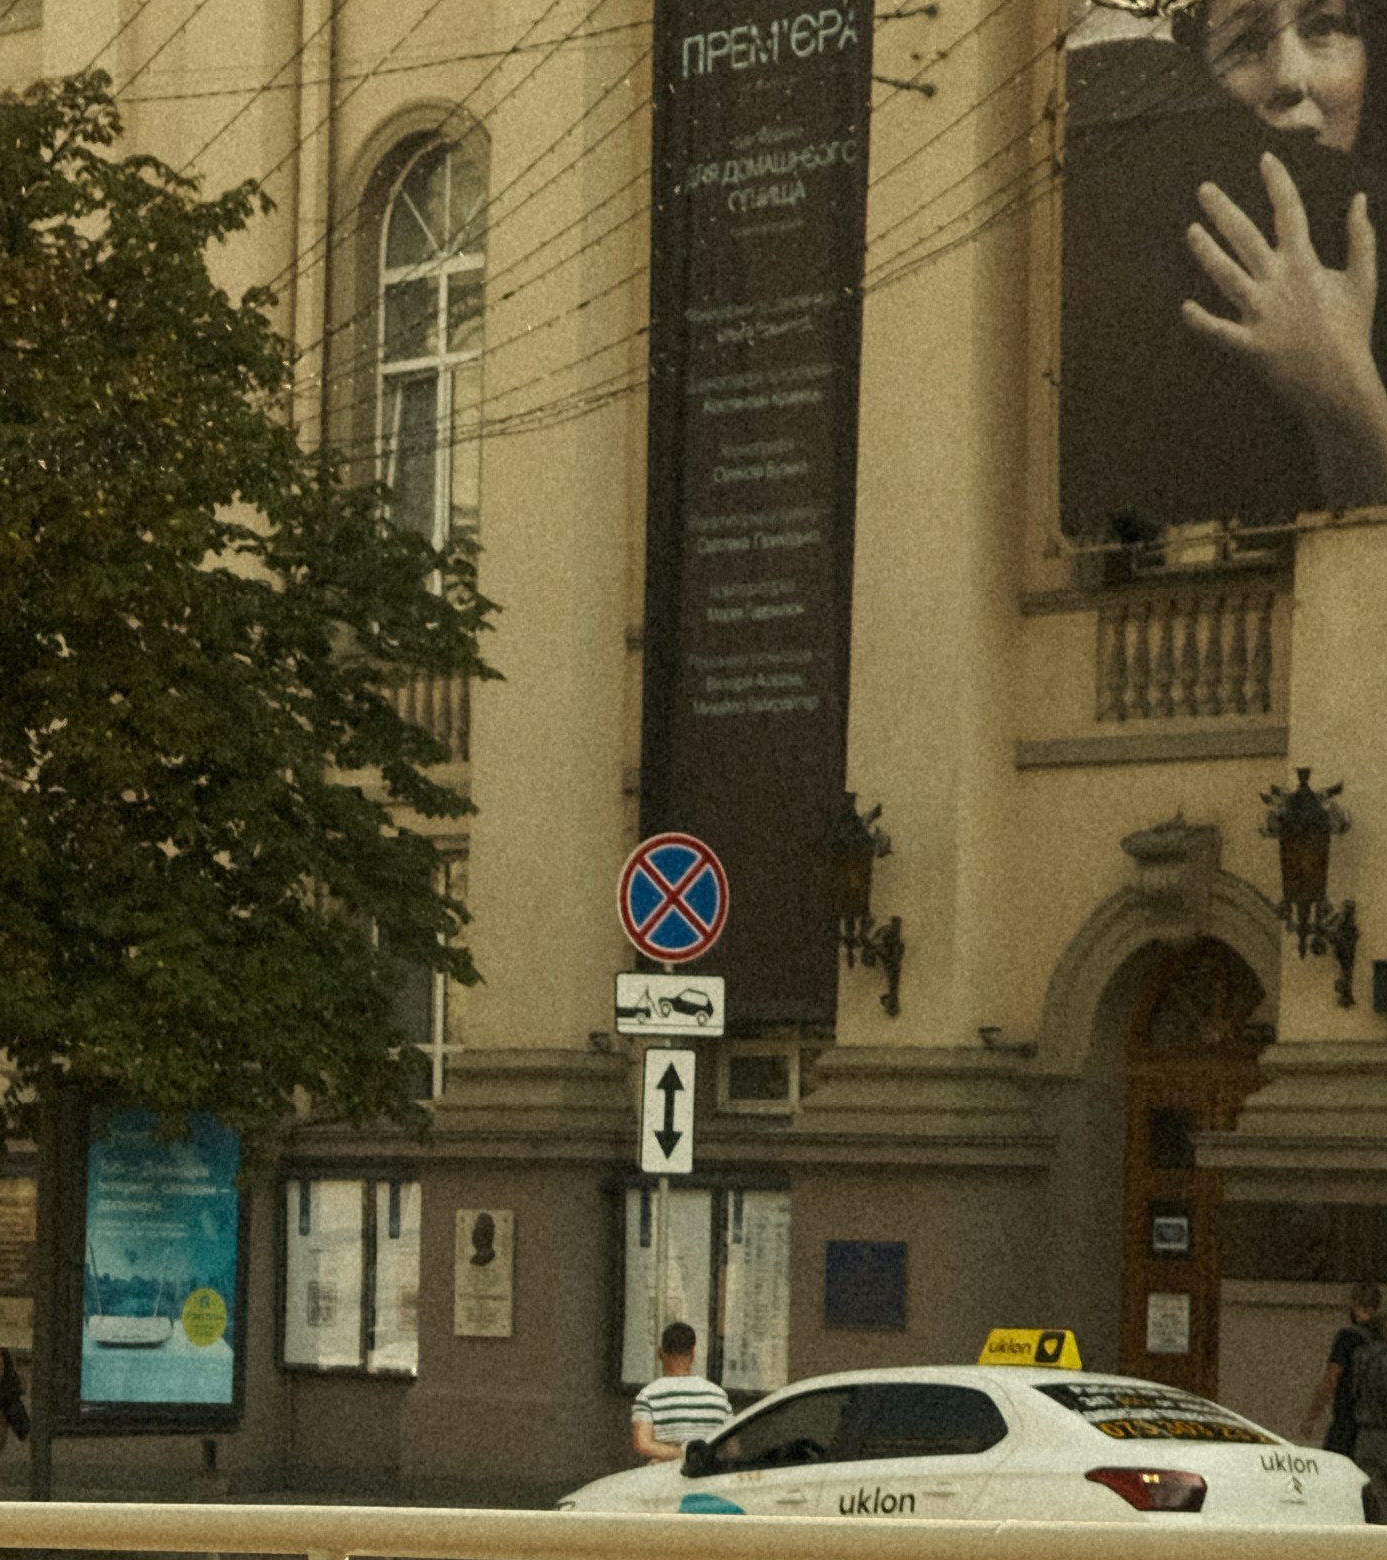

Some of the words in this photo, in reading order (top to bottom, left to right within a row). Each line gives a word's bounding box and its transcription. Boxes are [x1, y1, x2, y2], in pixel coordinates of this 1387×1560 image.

[988, 1338, 1031, 1355] uklon
[1260, 1452, 1320, 1475] uklon
[839, 1487, 916, 1515] uklon
